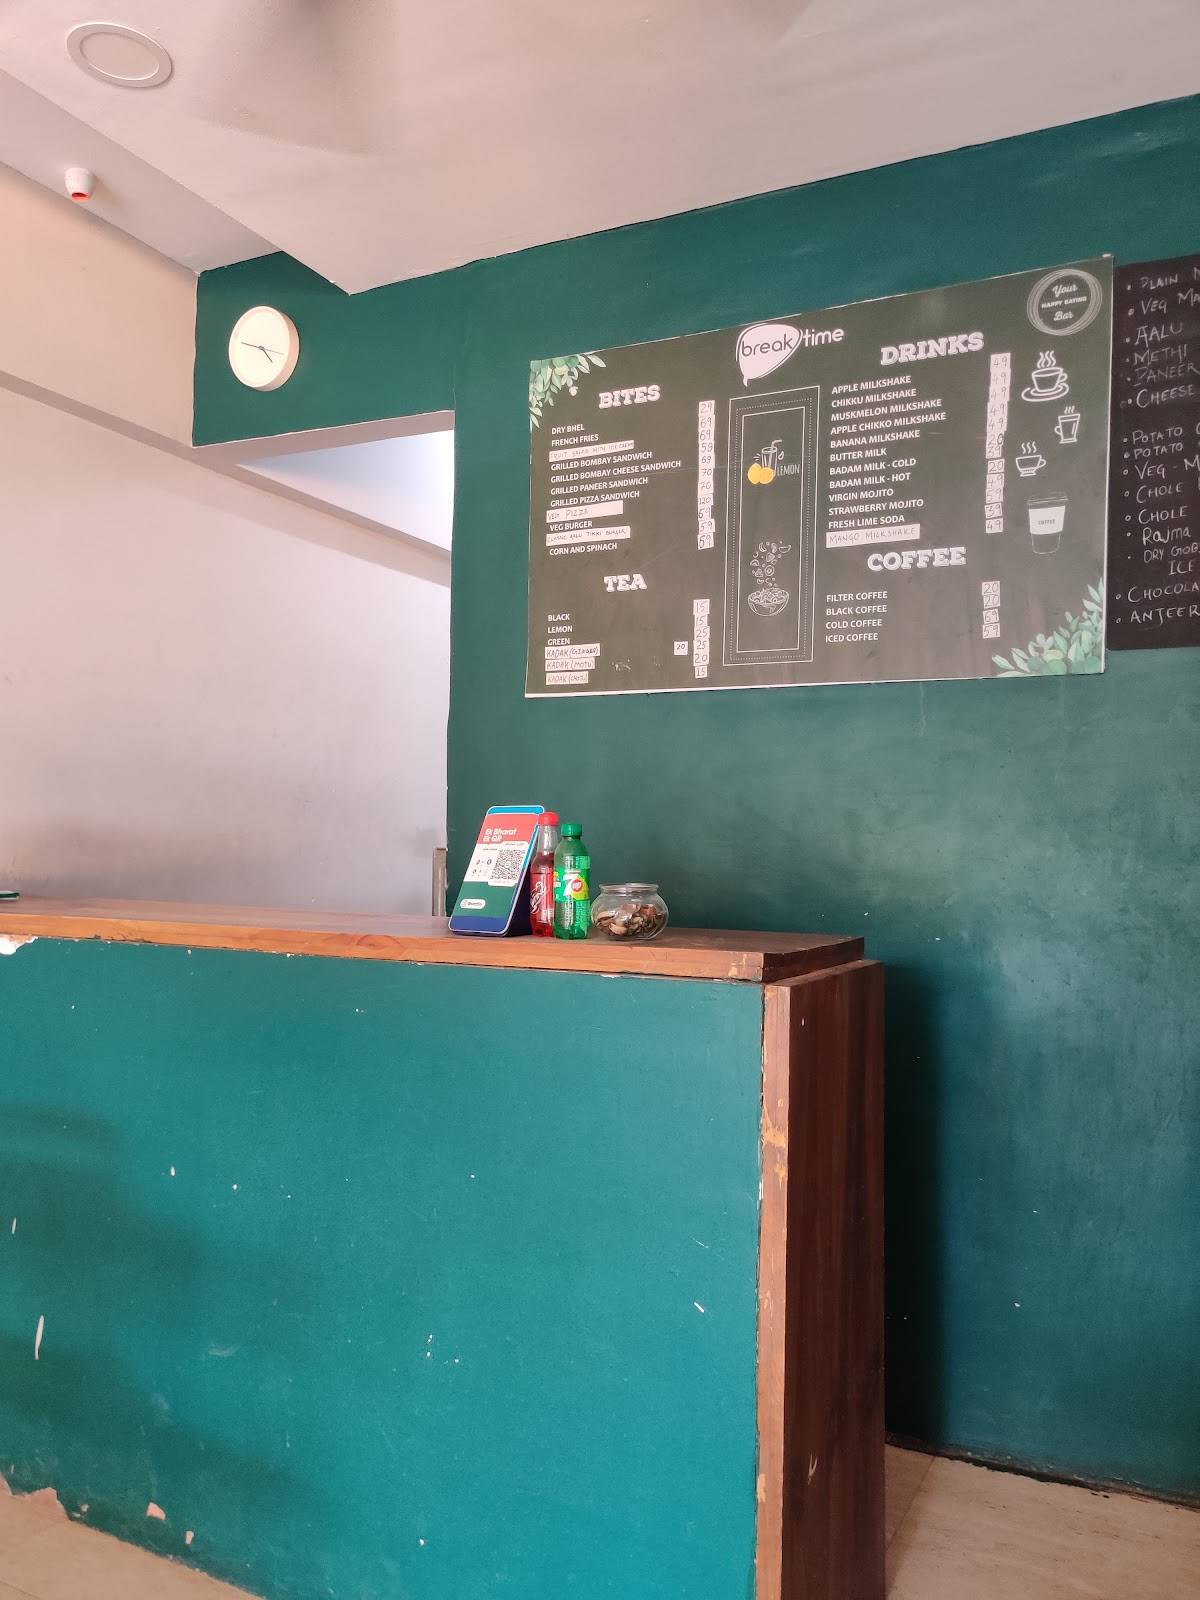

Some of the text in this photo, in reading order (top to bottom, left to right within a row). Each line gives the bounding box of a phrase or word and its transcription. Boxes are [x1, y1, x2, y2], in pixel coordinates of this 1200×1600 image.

[1140, 273, 1178, 289] PLAIN
[1052, 284, 1078, 297] Your
[1064, 296, 1087, 305] EATING
[1054, 311, 1074, 321] Bar
[742, 328, 844, 356] break time
[1134, 322, 1183, 348] AALU
[881, 332, 984, 365] DRINKS
[1133, 344, 1188, 365] METHI
[1135, 363, 1200, 382] PANEER
[832, 375, 911, 395] APPLE MILKSHAKE
[599, 385, 660, 409] BITES
[832, 389, 917, 408] CHIKKU MILKSHAKE
[1137, 384, 1195, 408] CHEESE
[831, 399, 942, 421] MUSKMELON MILKSHAKE
[552, 424, 584, 435] DRY BHEL
[831, 412, 946, 435] APPLE CHIKKO MILKSHAKE
[552, 434, 599, 446] FRENCH FRIES
[830, 430, 920, 448] BANANA MILKSHAKE
[1132, 427, 1183, 444] POTATO
[830, 449, 887, 462] BUTTER MILK
[1134, 442, 1183, 459] POTATO
[551, 452, 652, 471] GRILLED BOMBAY SANDWICH
[830, 465, 862, 475] BADAM
[864, 462, 886, 472] MILK
[892, 458, 916, 468] COLD
[551, 461, 681, 483] GRILLED BOMBAY CHEESE SANDWICH
[701, 468, 712, 476] 70
[777, 463, 800, 476] LEMON
[551, 477, 648, 495] GRILLED PANEER SANDWICH
[700, 482, 711, 490] 70
[830, 478, 862, 488] BADAM
[864, 475, 885, 485] MILK
[891, 473, 911, 482] HOT
[551, 491, 640, 507] GRILLED PIZZA SANDWICH
[829, 488, 894, 502] VIRGIN MOJITO
[1137, 482, 1183, 503] CHOLE
[699, 497, 711, 505] 120
[829, 499, 923, 515] STRAWBERRY MOJITO
[829, 515, 905, 529] FRESH LIME SODA
[1138, 506, 1188, 525] CHOLE
[550, 521, 592, 531] VEG BURGER
[829, 533, 859, 544] MANGO
[550, 547, 569, 556] CORN
[587, 543, 617, 552] SPINACH
[867, 547, 966, 571] COFFEE
[604, 574, 647, 592] TEA
[984, 583, 998, 594] 20
[826, 591, 888, 602] FILTER COFFEE
[696, 602, 705, 613] 15
[826, 605, 887, 616] BLACK COFFEE
[1131, 605, 1200, 625] ANJEER
[850, 619, 882, 627] COFFEE
[696, 626, 707, 638] 25
[826, 633, 878, 643] ICED COFFEE
[548, 638, 570, 646] GREEN
[697, 640, 707, 649] 25
[695, 654, 707, 663] 20
[697, 668, 705, 676] 15
